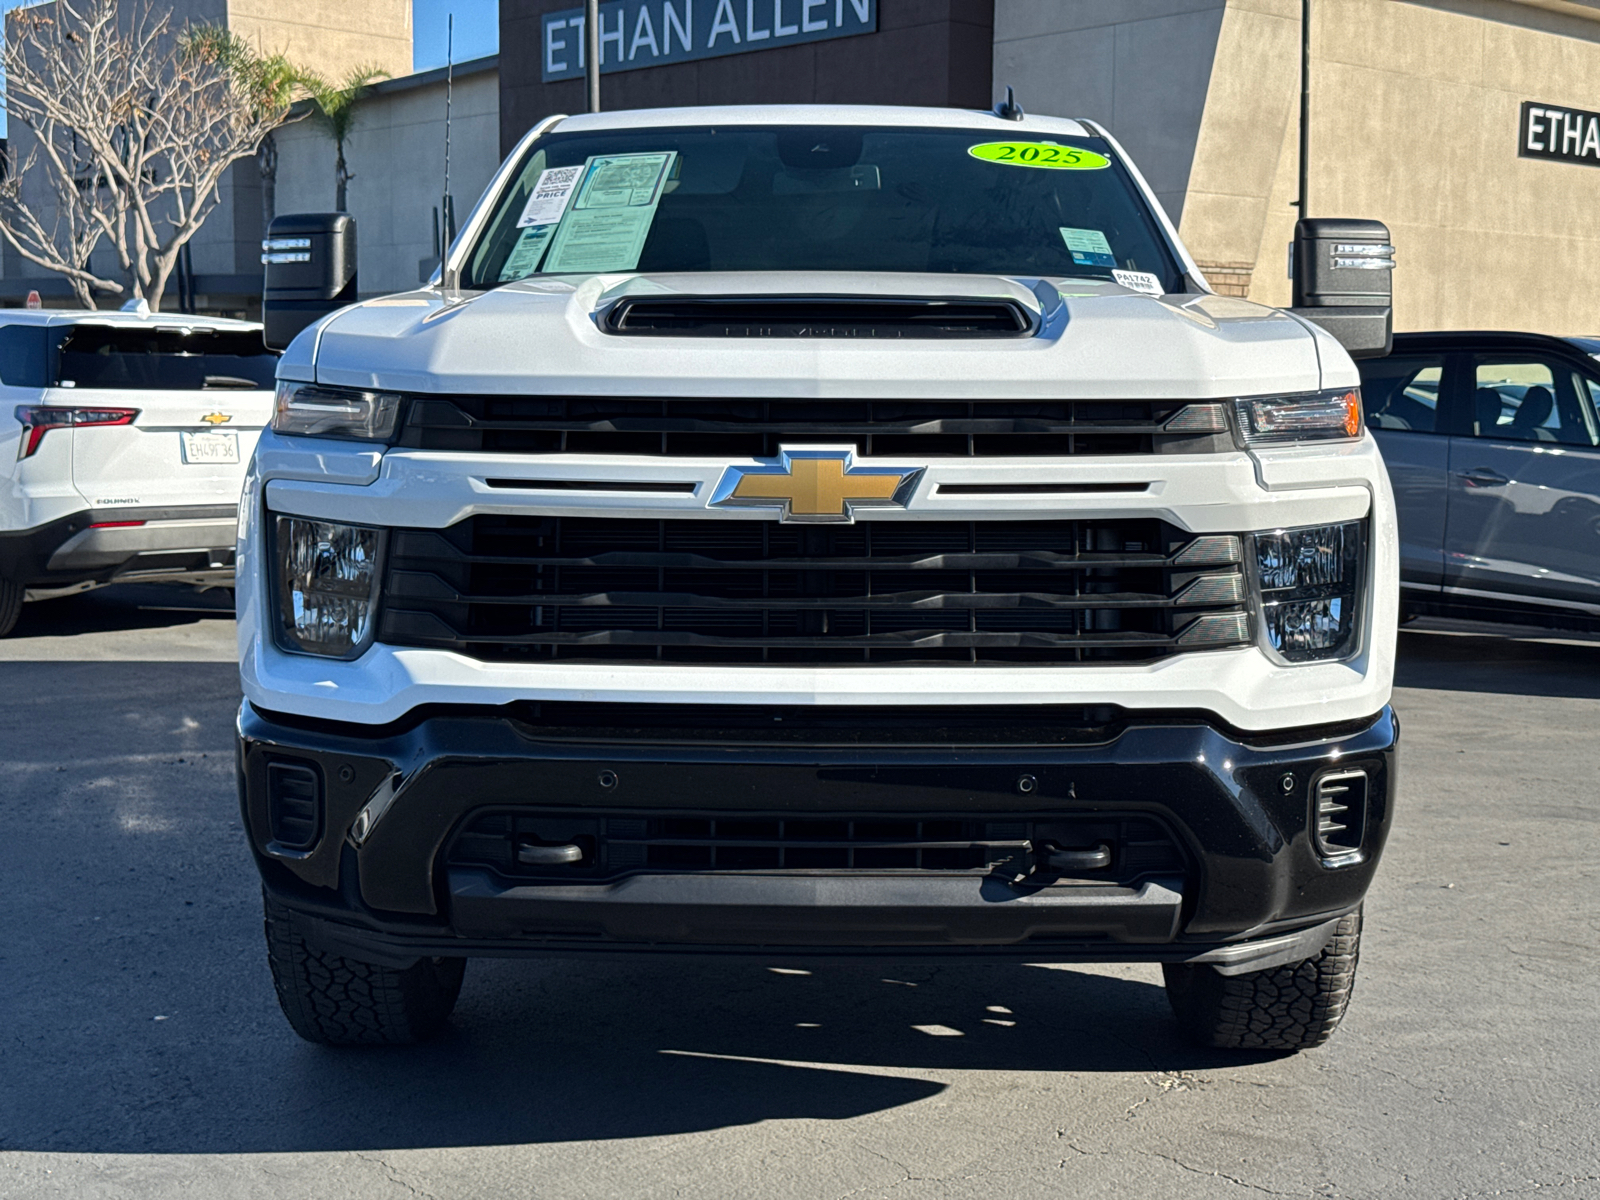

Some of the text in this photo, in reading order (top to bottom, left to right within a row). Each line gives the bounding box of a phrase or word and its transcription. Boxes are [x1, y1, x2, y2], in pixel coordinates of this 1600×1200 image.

[547, 0, 692, 73] ETHAN
[1527, 107, 1600, 159] ETHA
[996, 146, 1083, 164] 2025
[535, 190, 567, 199] PRICE
[1116, 273, 1152, 283] PA1742
